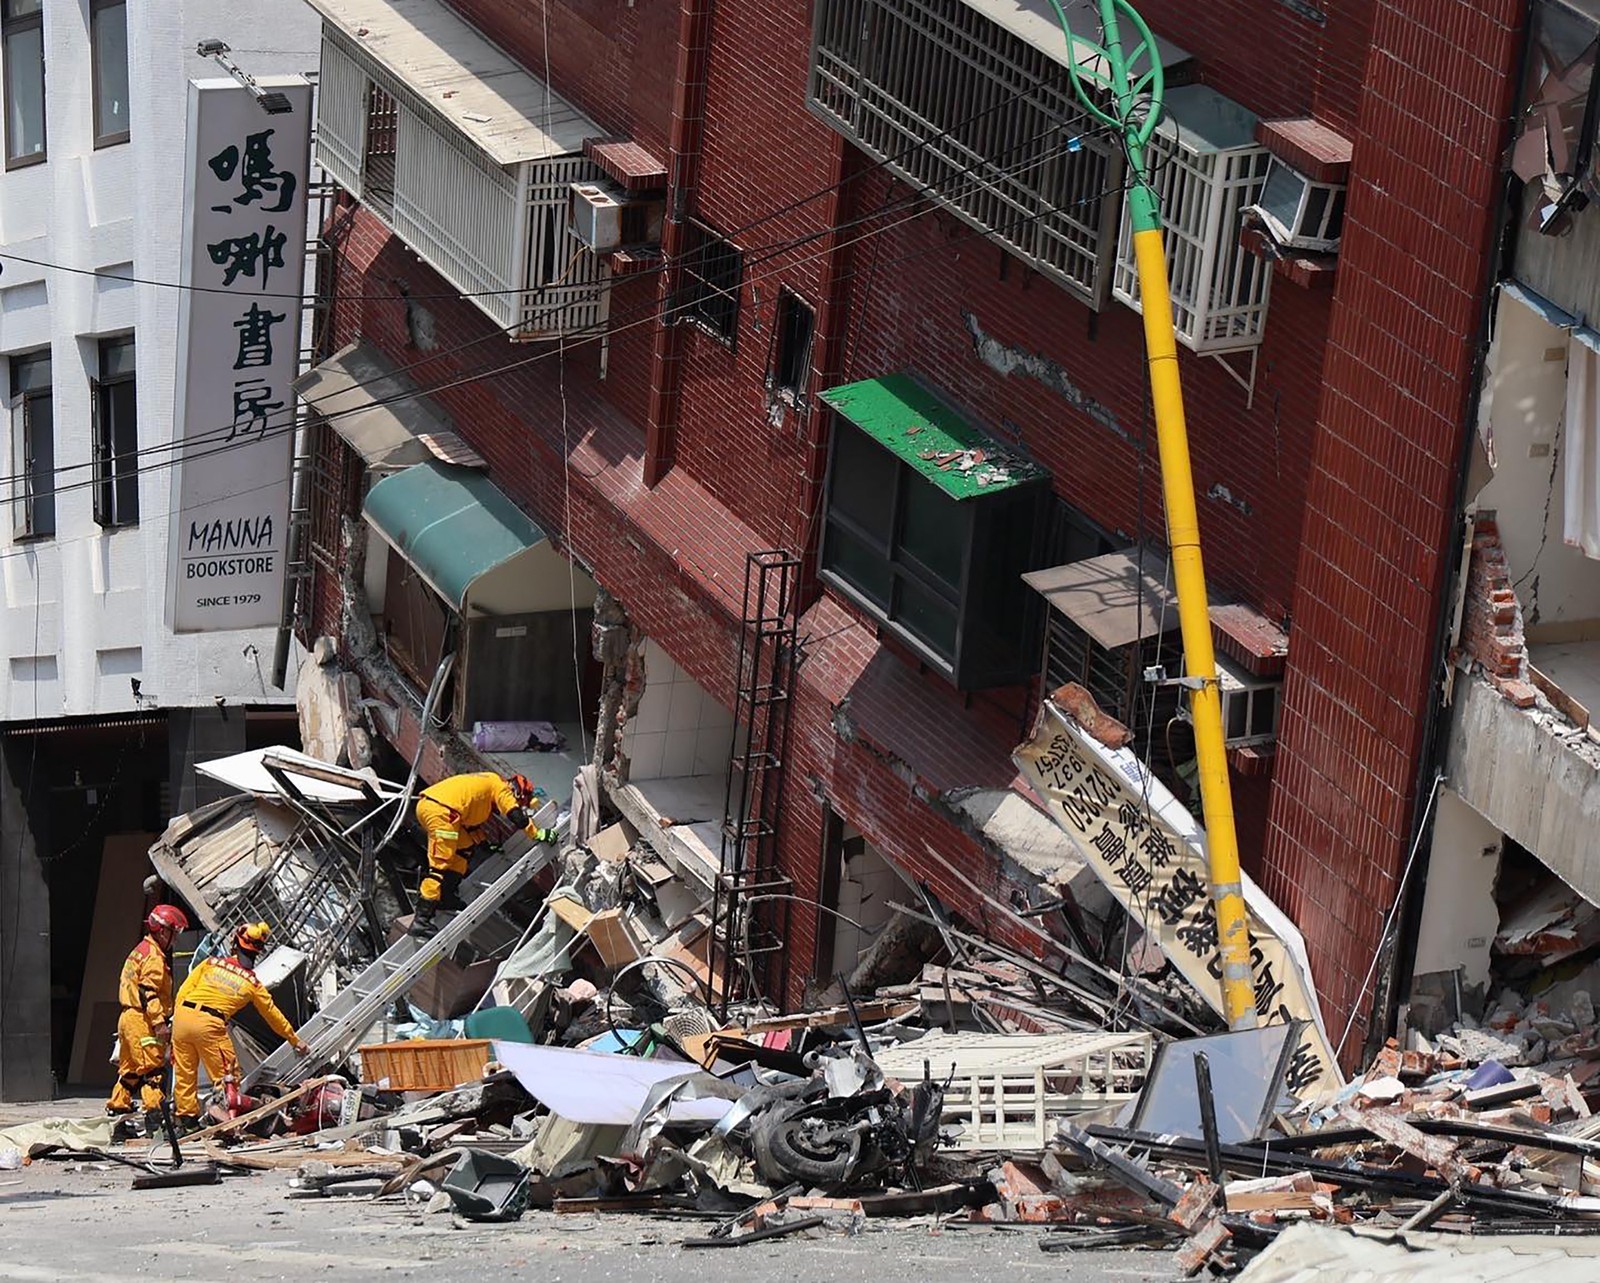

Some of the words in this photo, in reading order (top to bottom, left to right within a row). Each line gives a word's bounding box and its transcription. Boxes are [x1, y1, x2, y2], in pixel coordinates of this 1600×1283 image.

[188, 514, 273, 552] MANNA
[186, 557, 274, 579] BOOKSTORE
[196, 596, 231, 608] SINCE
[233, 594, 261, 605] 1979
[1090, 821, 1153, 895] 買賣
